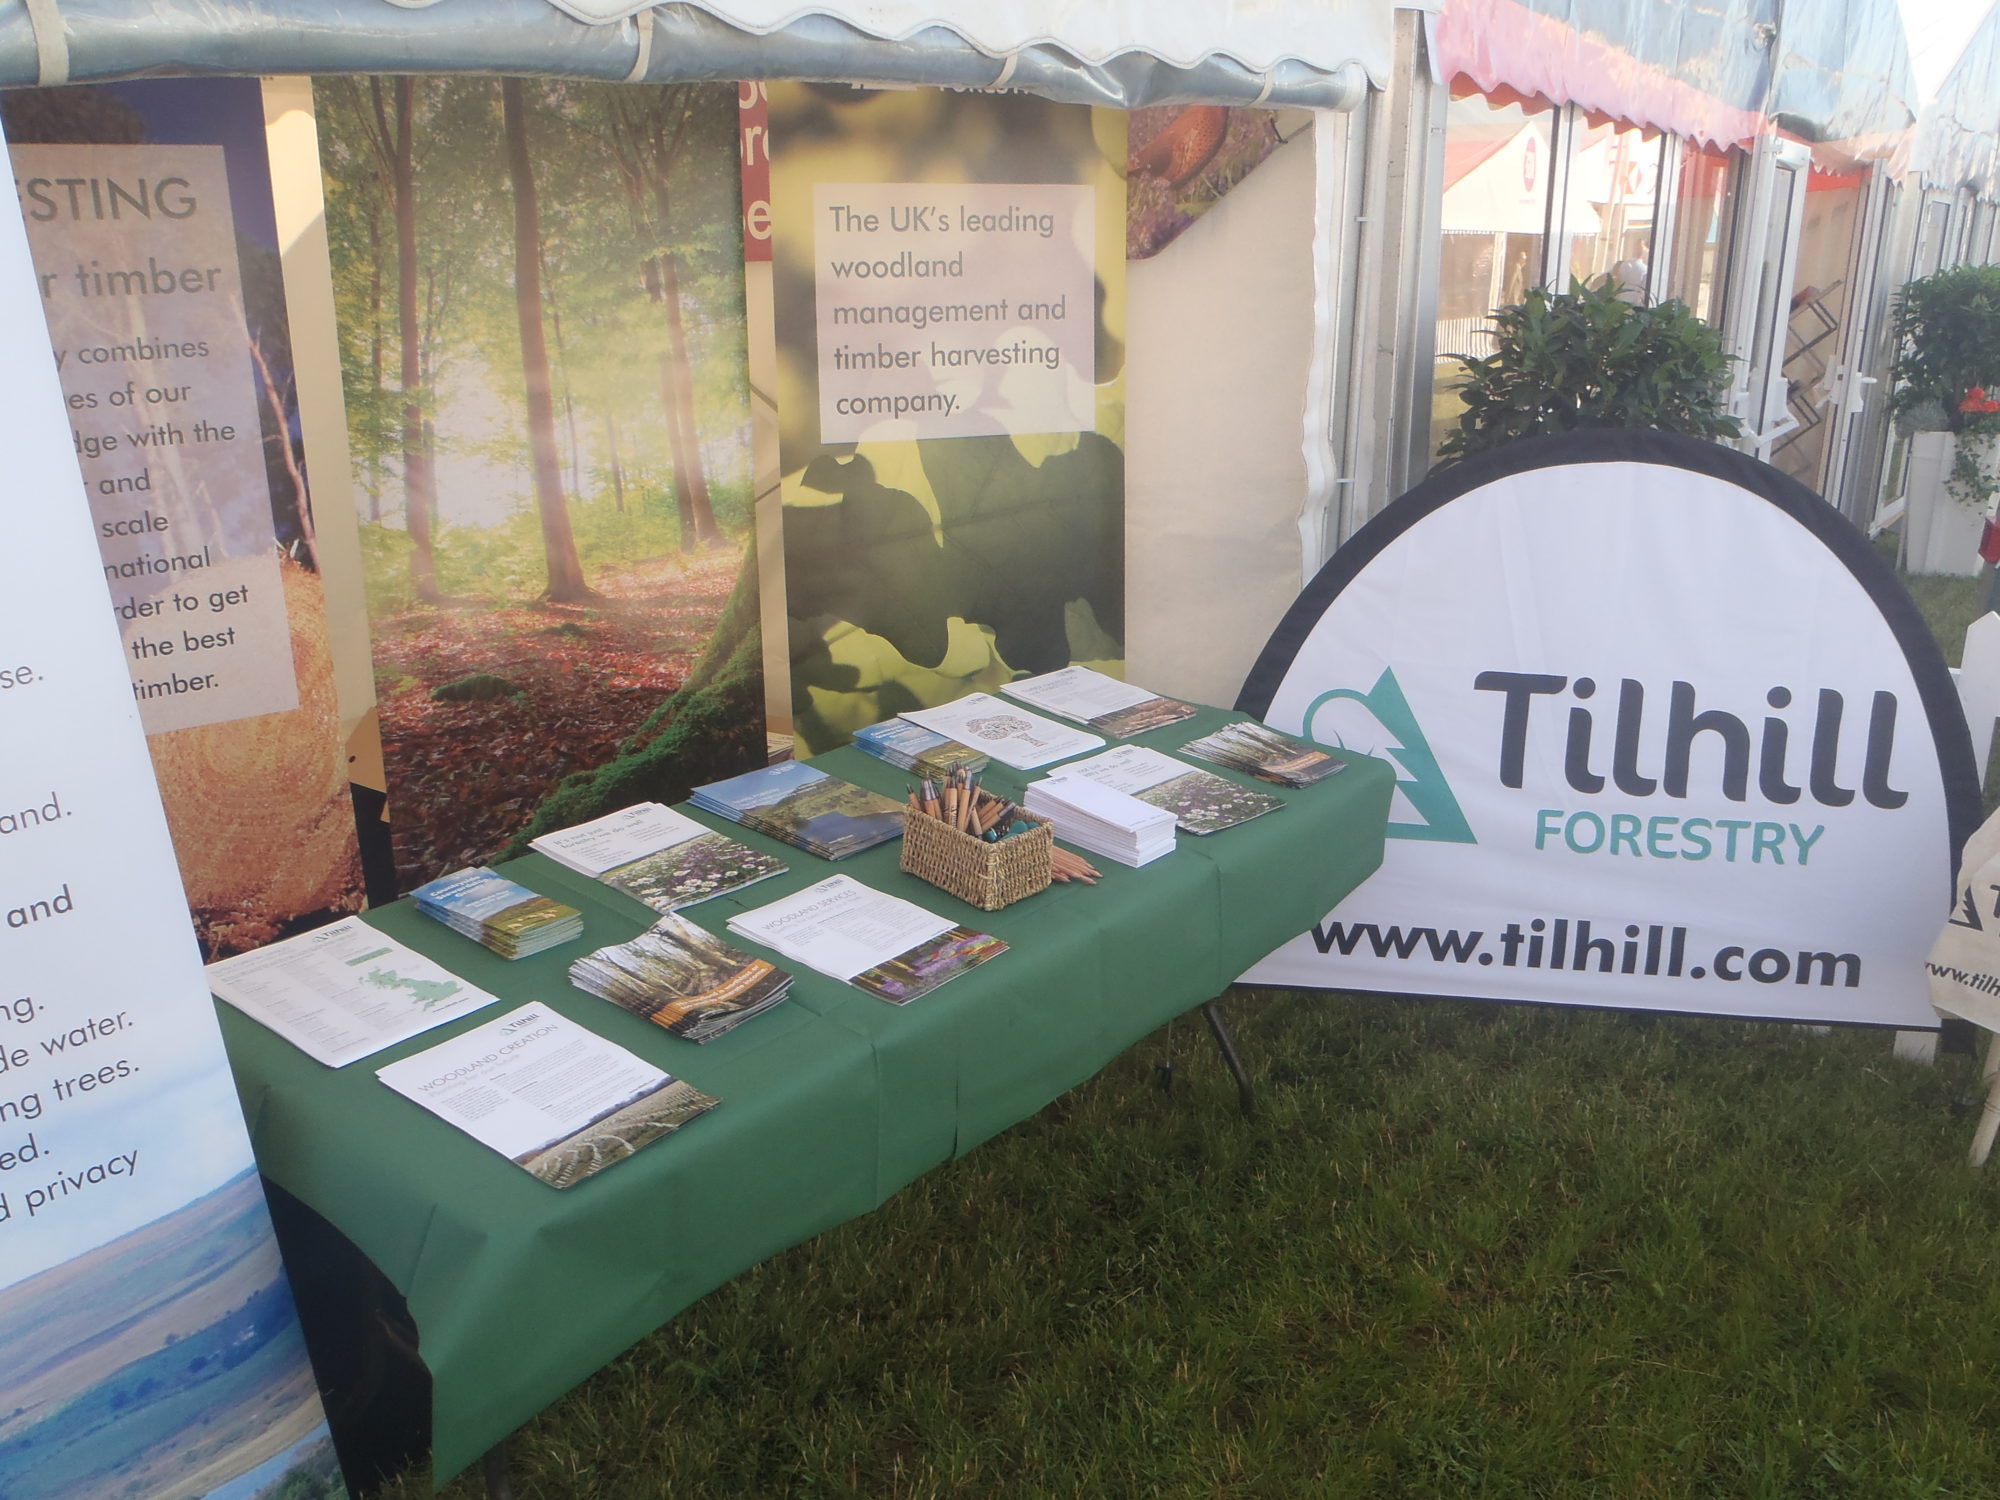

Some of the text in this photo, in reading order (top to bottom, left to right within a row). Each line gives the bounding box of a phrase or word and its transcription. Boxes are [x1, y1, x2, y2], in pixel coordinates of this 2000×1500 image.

[15, 177, 197, 221] STING
[829, 206, 1054, 238] The UK's leading
[75, 257, 222, 297] timber
[831, 251, 963, 278] woodland
[833, 294, 1066, 329] management and
[78, 336, 209, 364] combines
[834, 340, 1060, 370] timber harvesting
[109, 381, 135, 406] of
[145, 383, 192, 405] our
[836, 393, 961, 419] company.
[128, 421, 184, 447] with
[193, 420, 236, 442] the
[100, 468, 151, 494] and
[102, 510, 169, 538] scale
[103, 545, 211, 580] national
[173, 594, 199, 611] to
[209, 585, 249, 612] get
[131, 627, 236, 659] the best
[132, 673, 219, 701] timber.
[1474, 671, 1909, 810] Tilhill
[1534, 808, 1825, 866] FORESTRY
[7, 883, 73, 928] and
[1311, 918, 1861, 988] www.tilhill.com
[40, 1011, 133, 1056] water.
[509, 1013, 540, 1029] Tilhill
[418, 1053, 498, 1093] WOODLAND
[499, 1024, 558, 1056] CREATION
[53, 1060, 139, 1101] trees.
[25, 1149, 137, 1217] privacy
